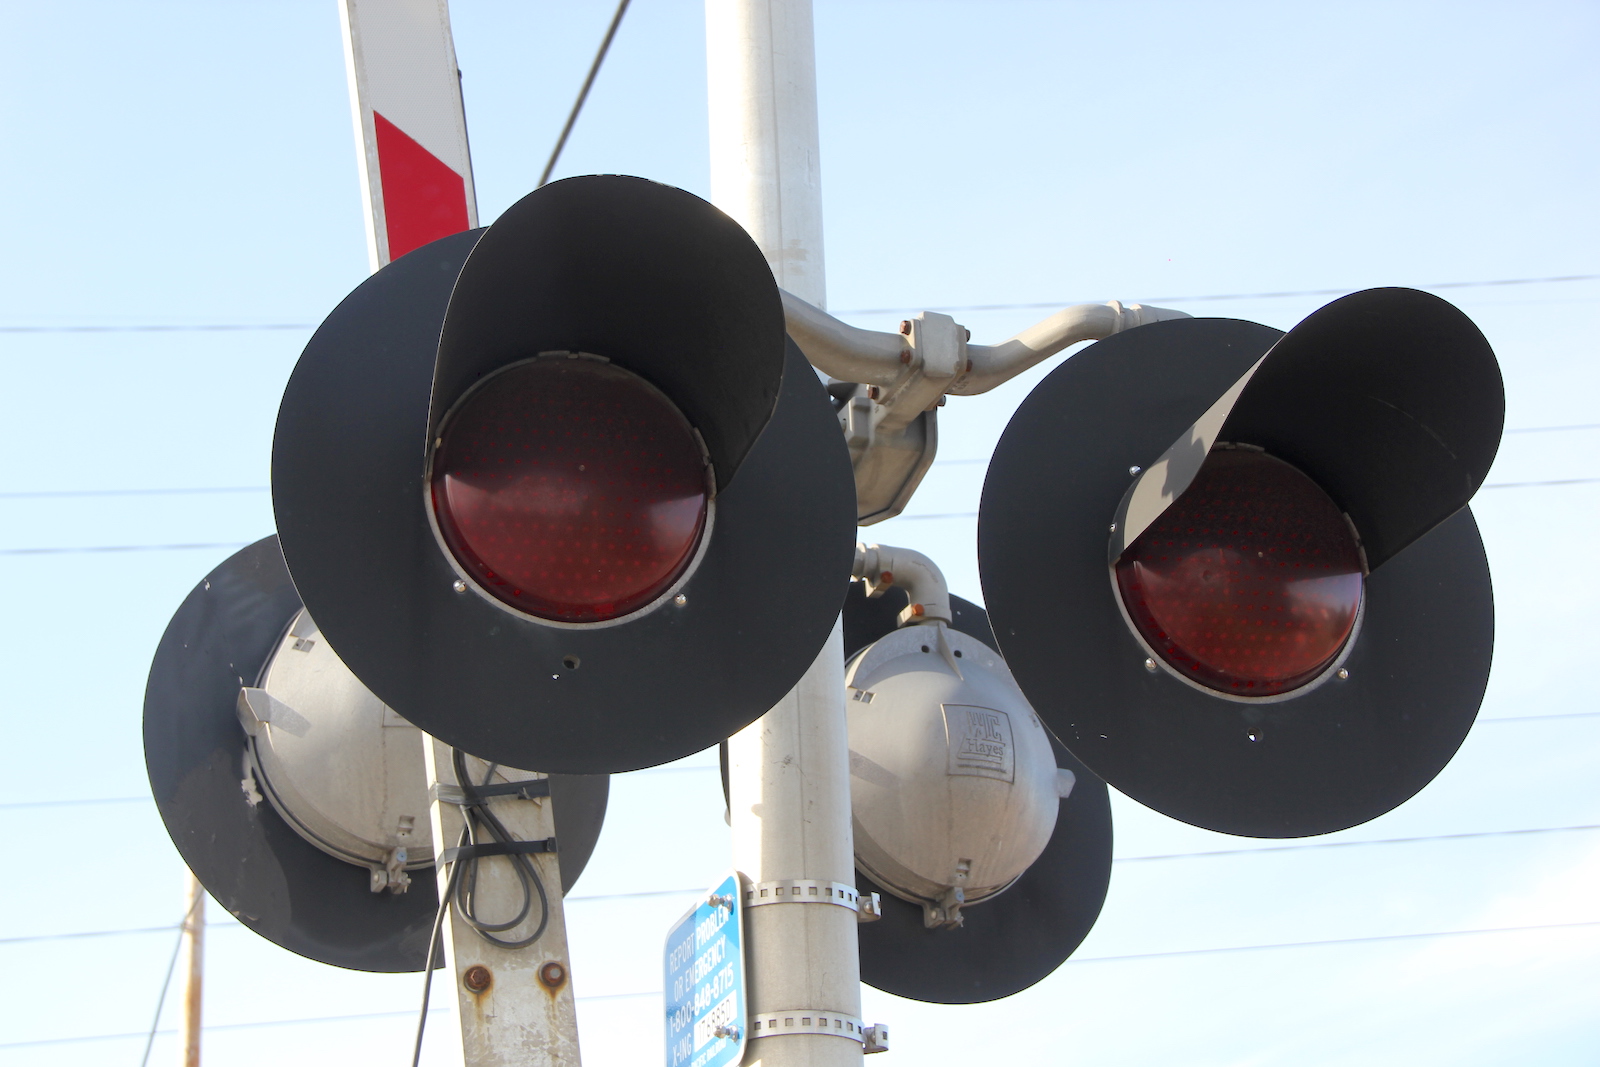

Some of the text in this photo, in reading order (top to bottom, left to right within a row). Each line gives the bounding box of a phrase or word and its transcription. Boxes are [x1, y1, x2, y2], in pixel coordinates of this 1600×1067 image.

[965, 738, 1004, 757] Hayes
[670, 903, 729, 975] REPORT PROBLEM
[674, 934, 726, 1003] OR EMERGENCY
[669, 961, 734, 1038] 1-800-848-8715
[672, 1032, 692, 1067] X-ING
